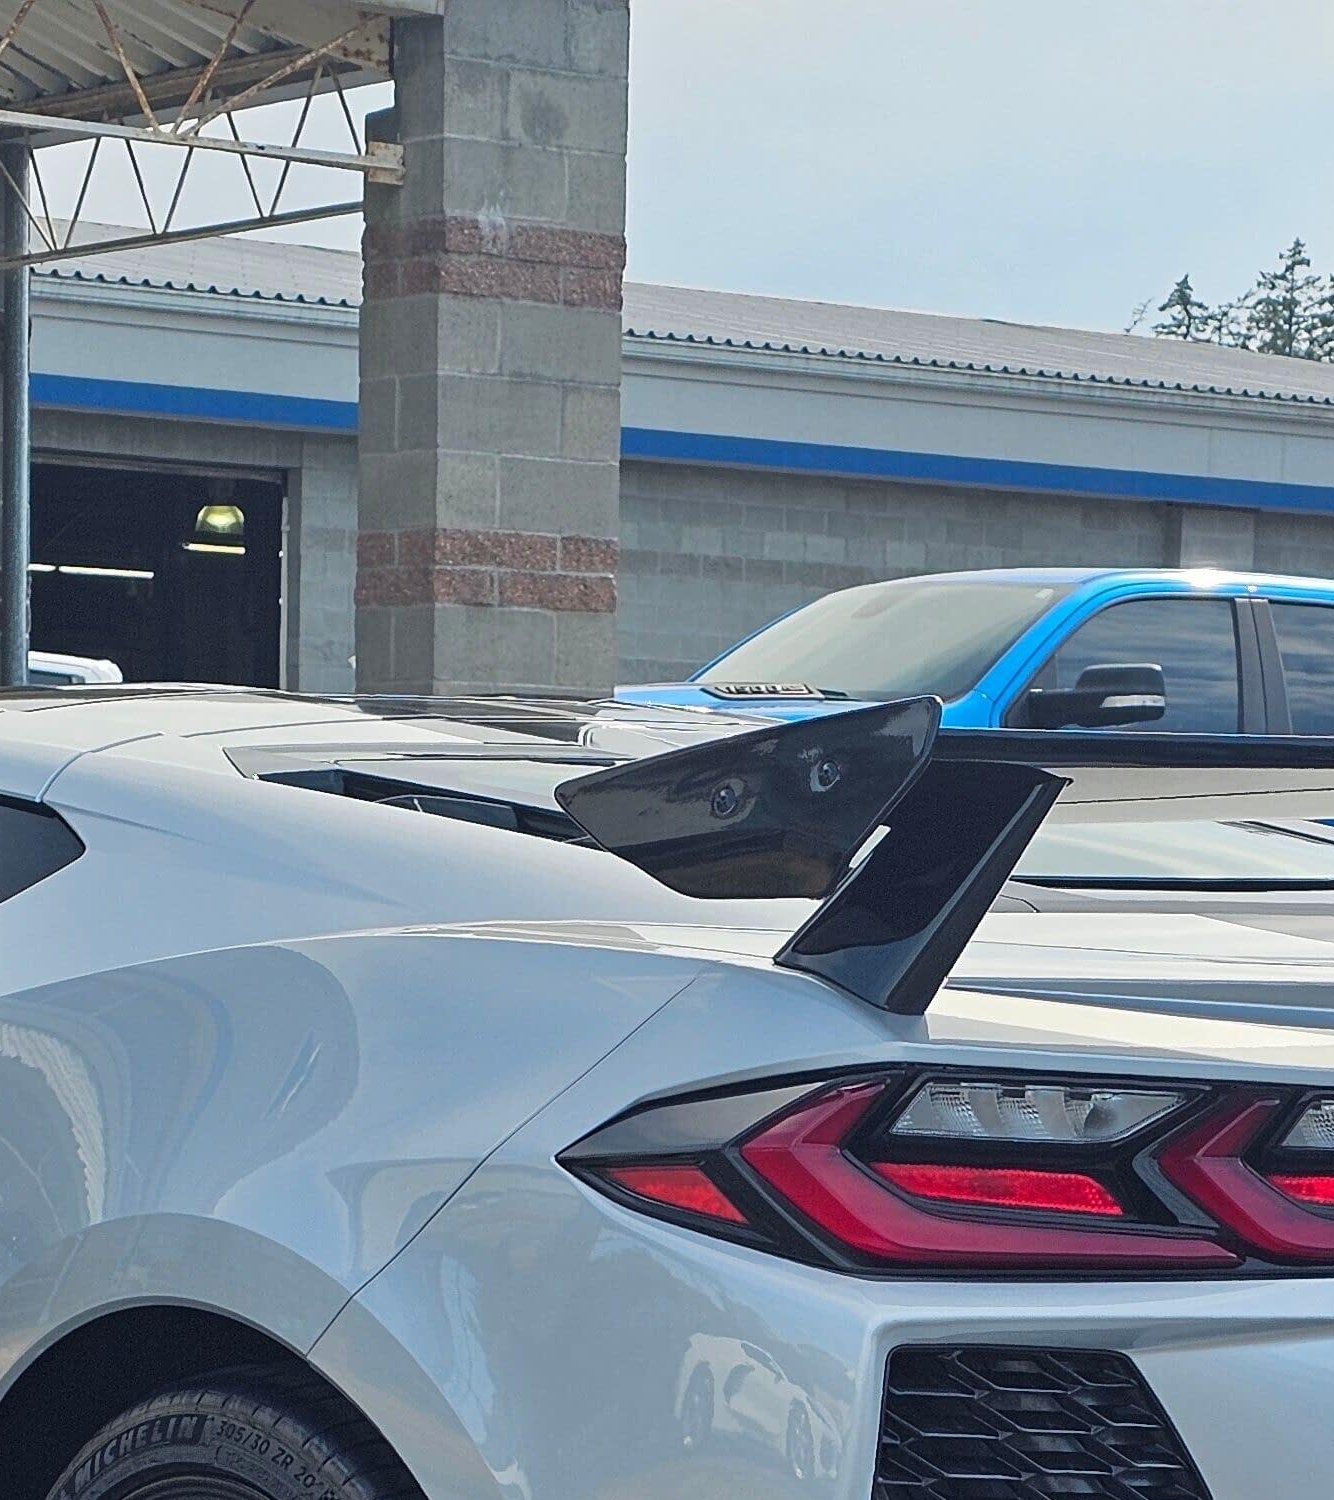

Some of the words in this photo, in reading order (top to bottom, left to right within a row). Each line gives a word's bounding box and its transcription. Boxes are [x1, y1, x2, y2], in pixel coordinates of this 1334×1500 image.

[74, 1415, 199, 1494] MICHELIN
[215, 1420, 271, 1456] 305/30
[271, 1446, 295, 1470] ZR
